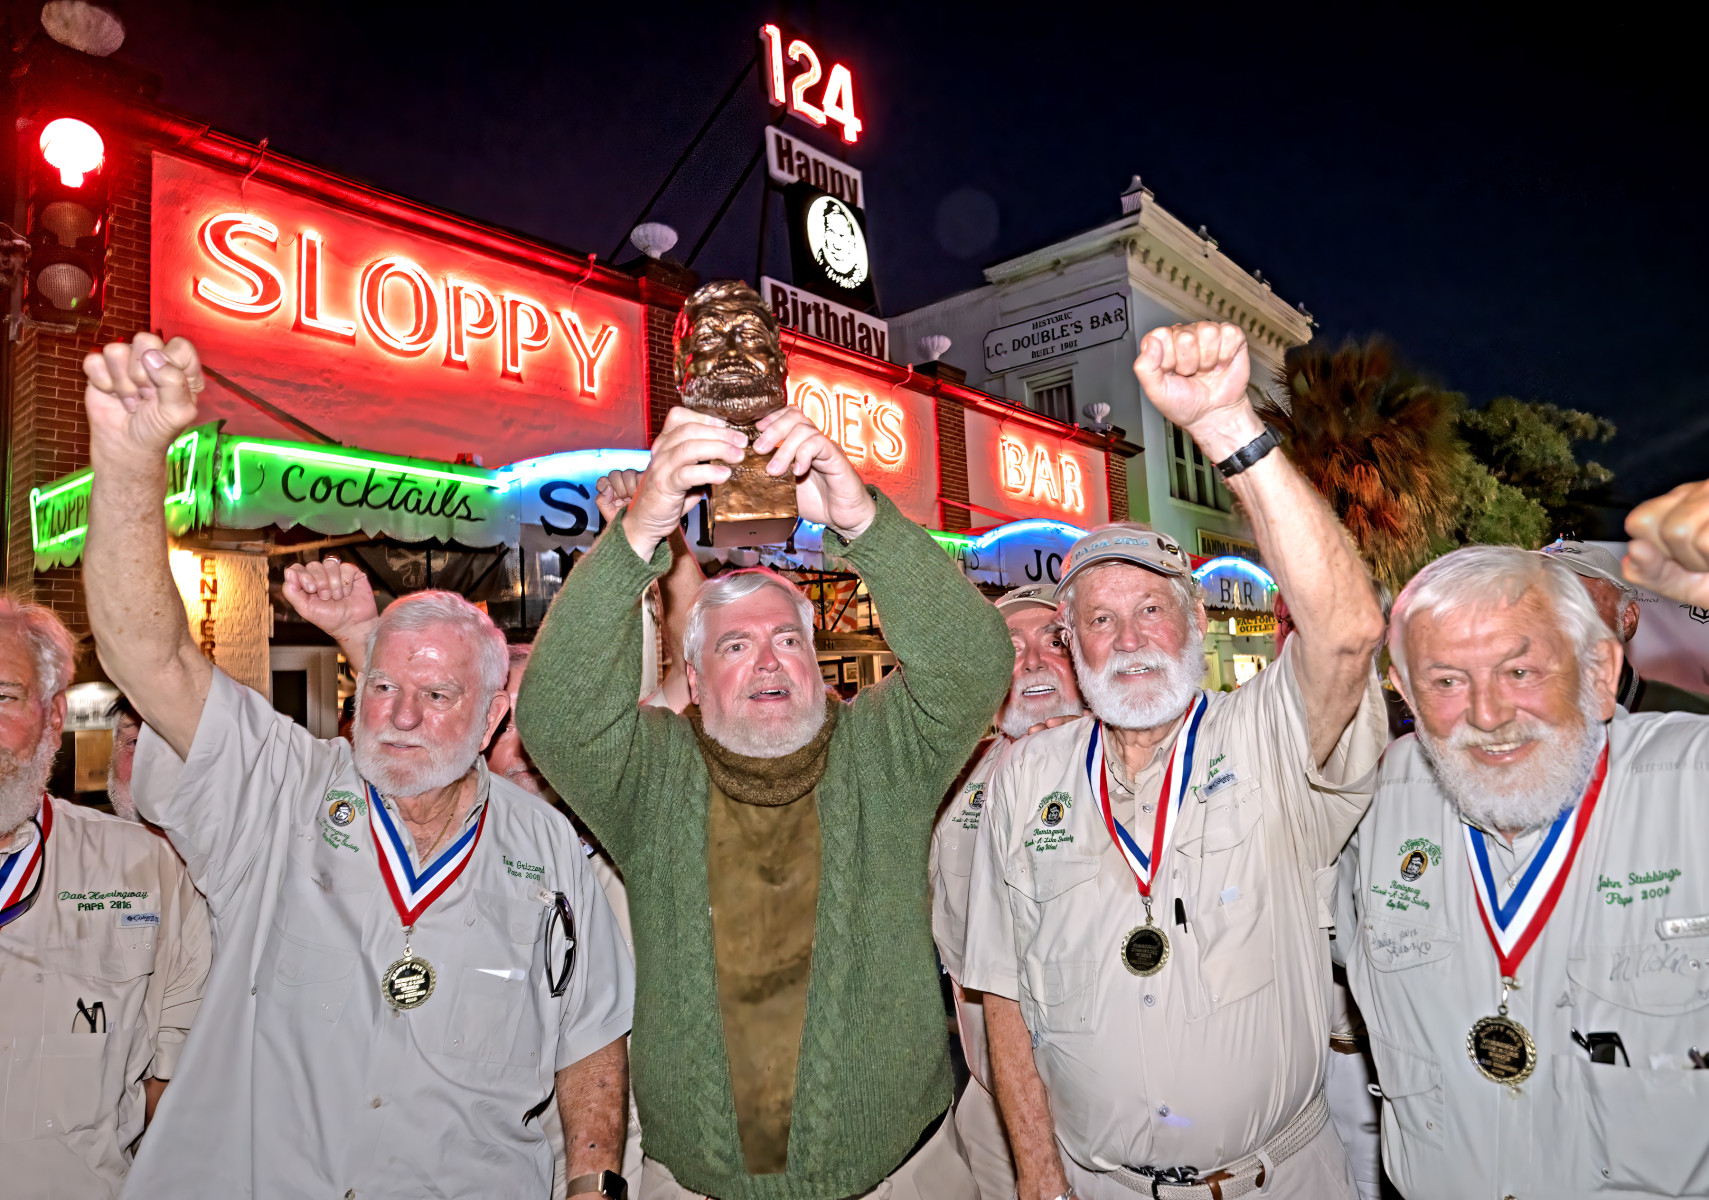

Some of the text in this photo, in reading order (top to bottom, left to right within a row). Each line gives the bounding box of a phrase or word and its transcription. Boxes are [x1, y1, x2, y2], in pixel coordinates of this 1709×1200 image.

[761, 23, 862, 143] 124
[773, 132, 859, 204] Happy
[769, 282, 887, 362] Birthday
[1012, 320, 1083, 352] DOUBLE'S
[1090, 307, 1125, 330] BAR
[1031, 311, 1074, 330] HISTORIC
[193, 212, 1086, 513] SLOPPY OE'S BAR
[281, 464, 486, 522] Cocktails
[1075, 540, 1110, 561] PAPA
[1220, 577, 1254, 606] BAR
[57, 890, 87, 900] Dave
[77, 902, 105, 911] PAPA
